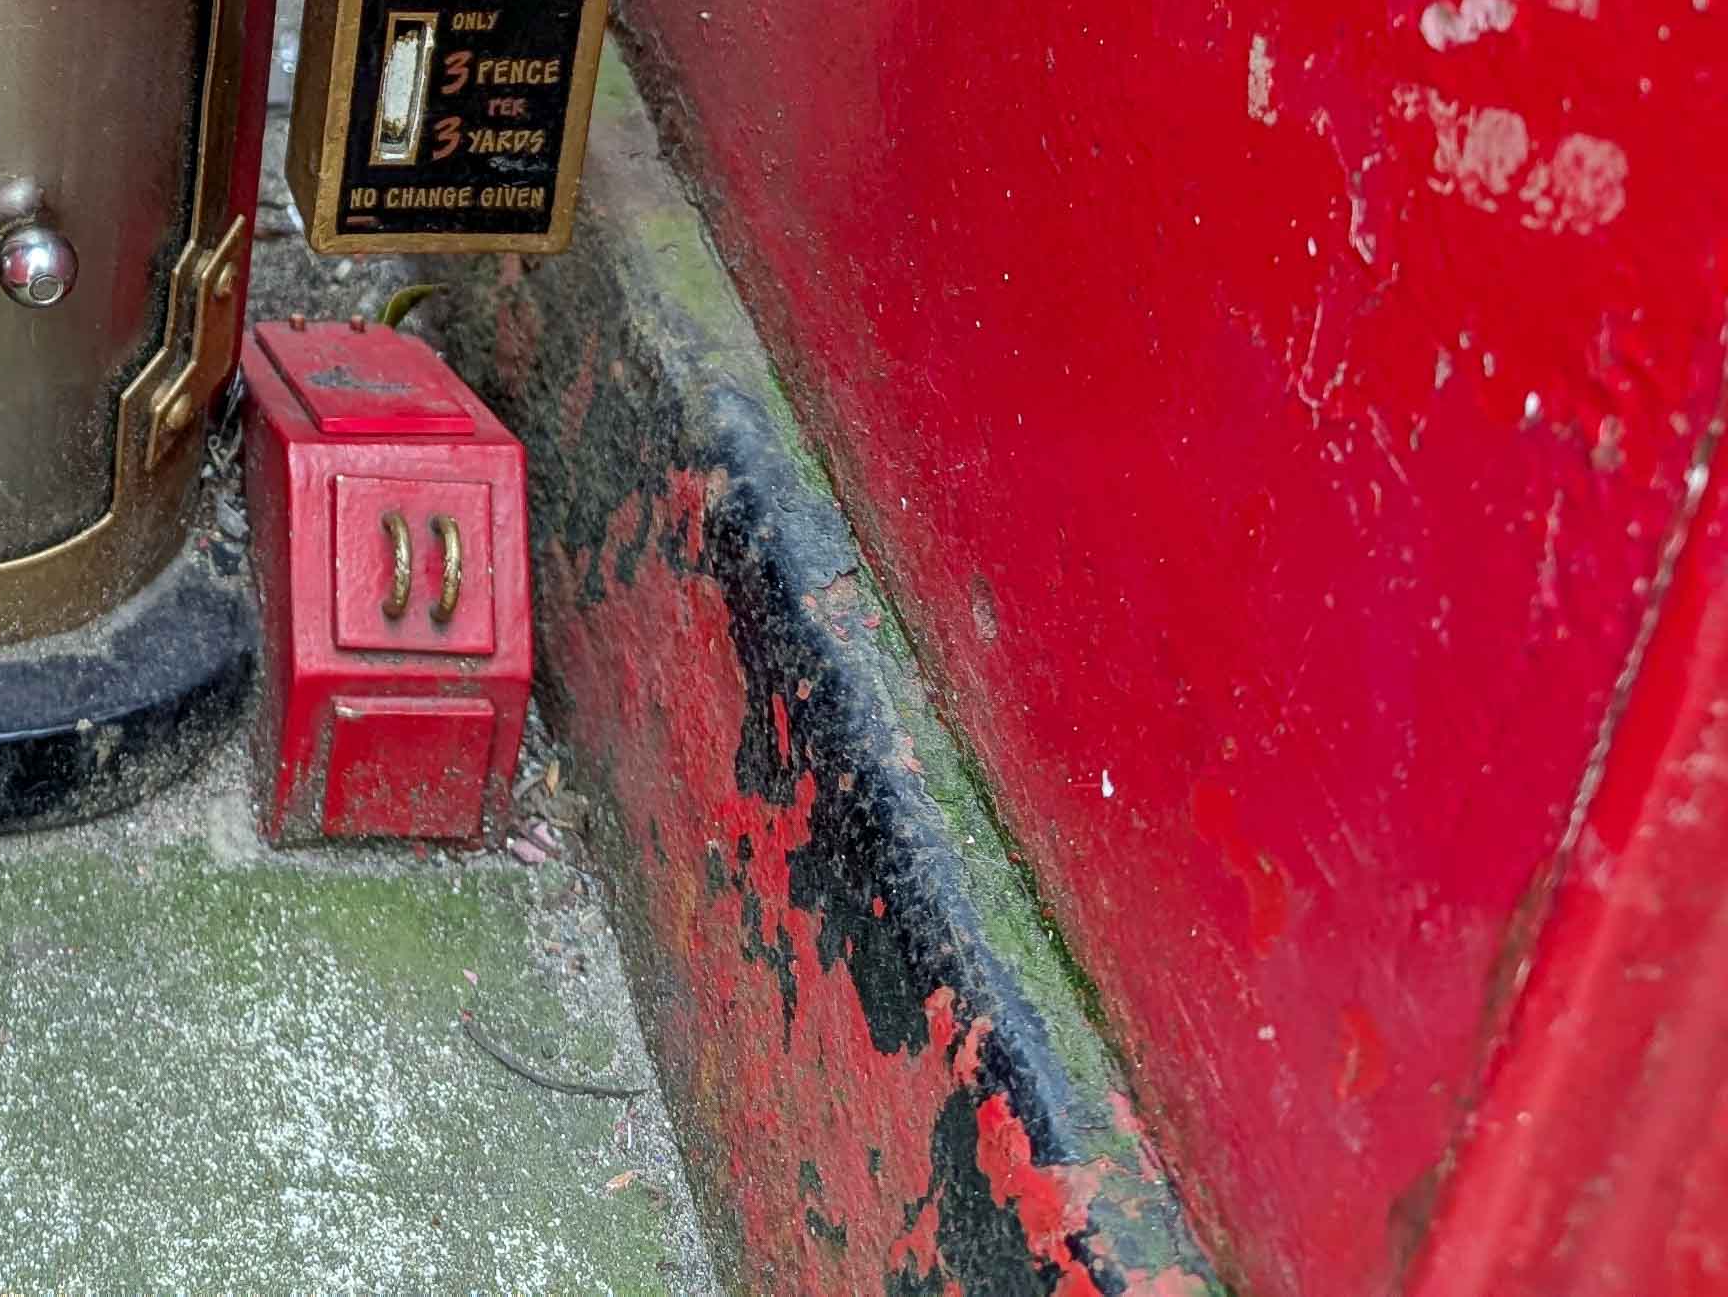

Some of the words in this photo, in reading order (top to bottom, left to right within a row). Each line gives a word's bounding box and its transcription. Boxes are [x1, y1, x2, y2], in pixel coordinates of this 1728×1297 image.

[452, 12, 497, 30] ONLY
[441, 50, 472, 95] 3
[476, 59, 560, 84] PENCE
[488, 98, 526, 117] PER
[432, 116, 462, 160] 3
[468, 129, 545, 153] YARDS
[350, 188, 377, 207] NO
[387, 186, 472, 207] CHANGE
[480, 187, 545, 207] GIVEN
